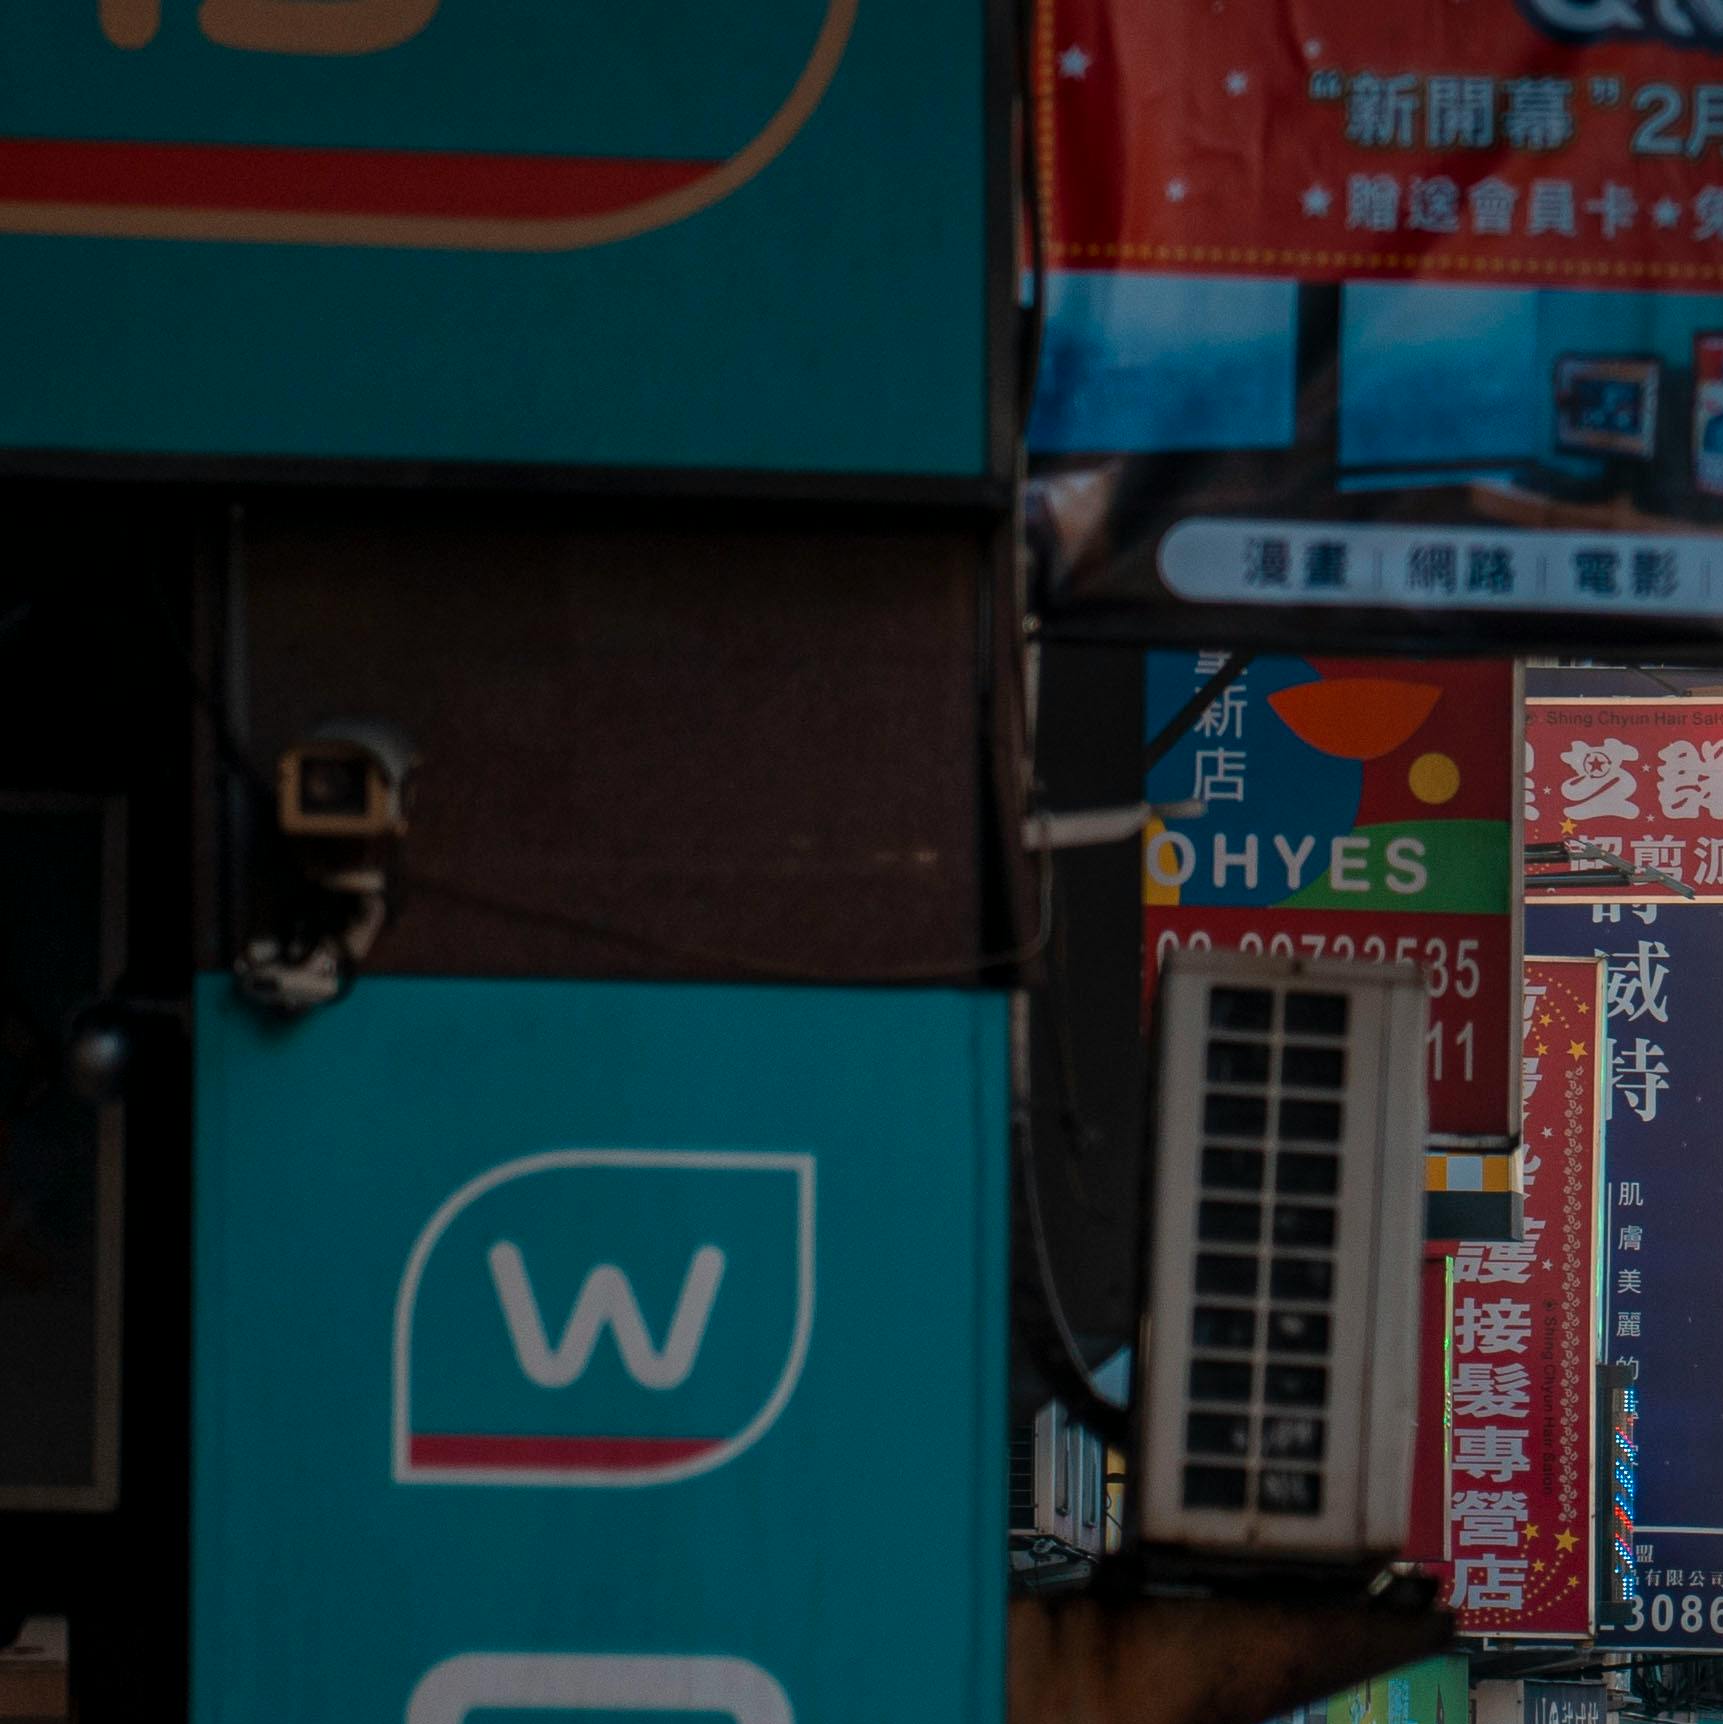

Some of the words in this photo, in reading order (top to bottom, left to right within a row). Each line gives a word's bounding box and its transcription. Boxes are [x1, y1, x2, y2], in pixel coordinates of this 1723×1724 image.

[1546, 711, 1594, 728] Shing
[1655, 711, 1688, 726] Hair
[1146, 832, 1429, 894] OHYES
